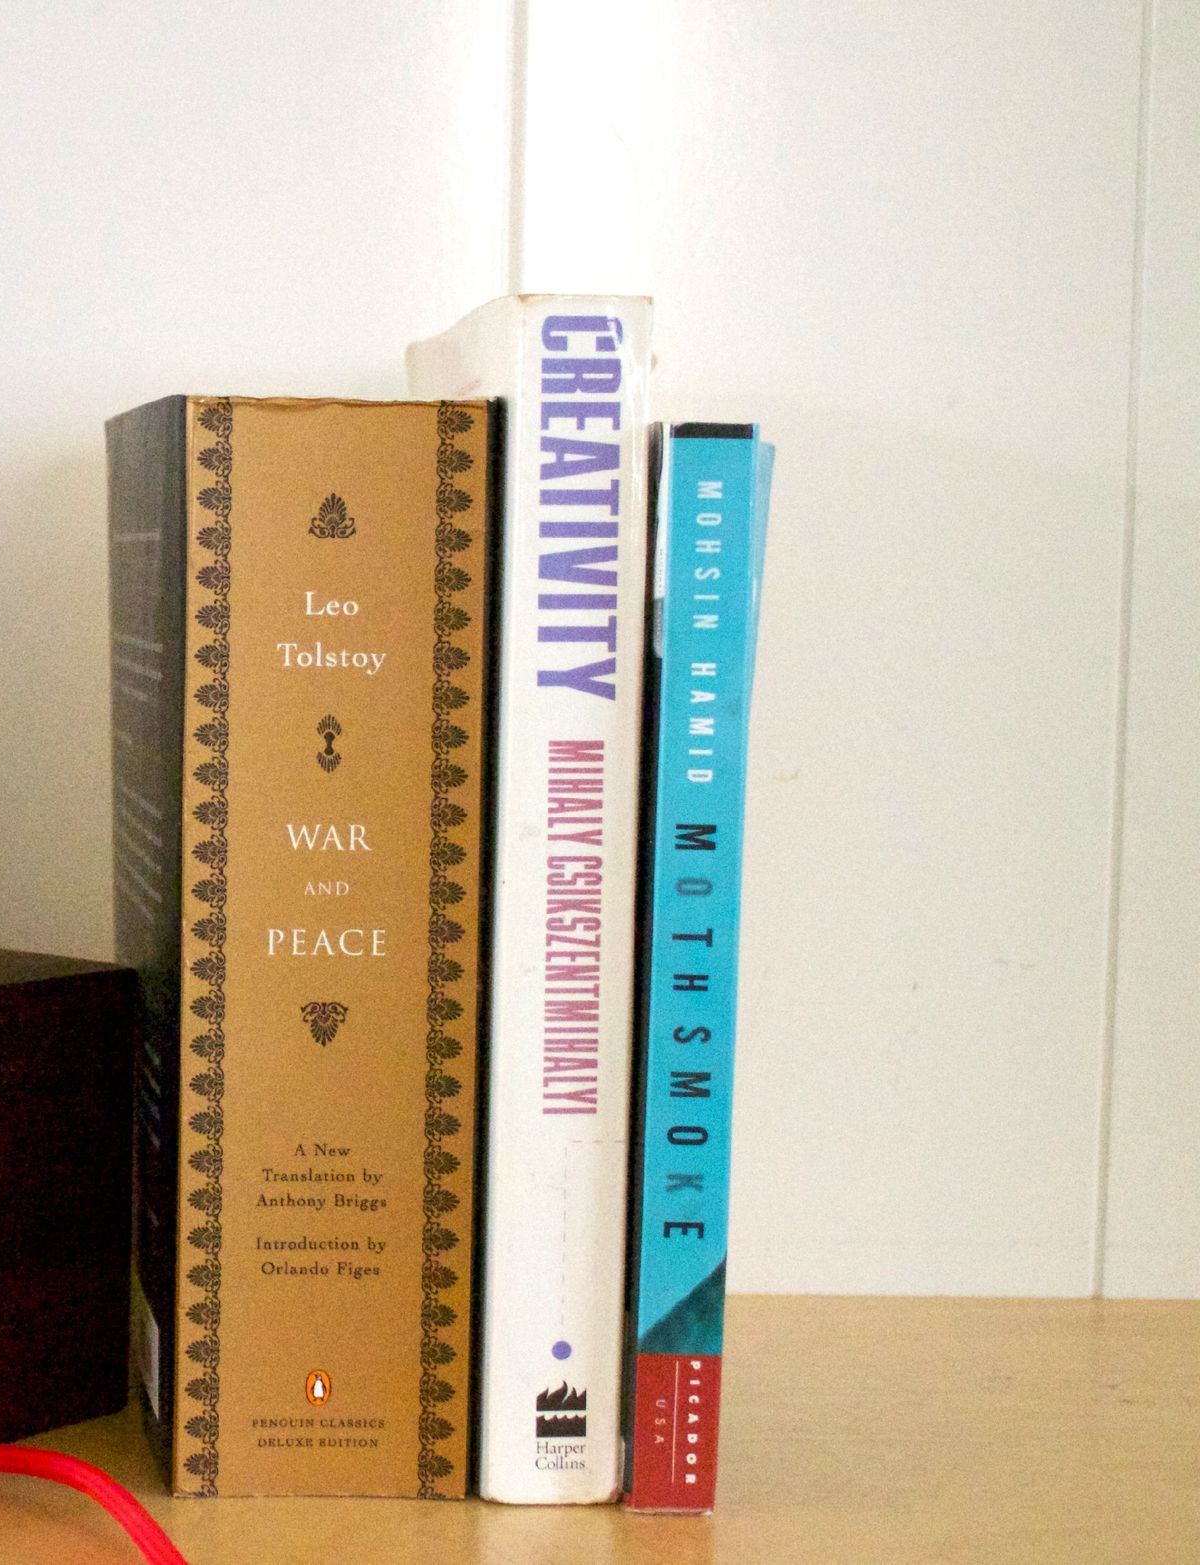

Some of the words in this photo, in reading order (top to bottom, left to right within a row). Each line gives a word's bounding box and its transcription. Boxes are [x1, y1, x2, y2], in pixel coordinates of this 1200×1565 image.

[536, 315, 623, 702] CREATIVITY
[693, 480, 723, 629] MOHSIN
[305, 592, 359, 616] Leo
[277, 642, 387, 675] Tolstoy
[687, 661, 717, 784] HAMID
[547, 740, 605, 846] MIHALY
[287, 824, 372, 851] WAR
[304, 881, 349, 896] AND
[267, 928, 386, 956] PEACE
[542, 855, 603, 1115] CSIKSZENTMIHALYI
[294, 1144, 307, 1156] A
[314, 1143, 351, 1157] New
[261, 1168, 356, 1182] Translation
[363, 1168, 383, 1186] by
[256, 1193, 326, 1211] Anthony
[334, 1194, 387, 1212] Briggs
[256, 1236, 360, 1251] Introduction
[367, 1237, 387, 1254] by
[261, 1261, 330, 1276] Orlando
[337, 1261, 380, 1280] Figes
[252, 1418, 315, 1428] PENGUIN
[320, 1418, 386, 1429] CLASSICS
[685, 1360, 702, 1484] PICADOR
[257, 1437, 314, 1448] DELUXE
[319, 1437, 379, 1448] EDITION
[536, 1441, 587, 1458] Harper
[534, 1456, 586, 1471] Collins
